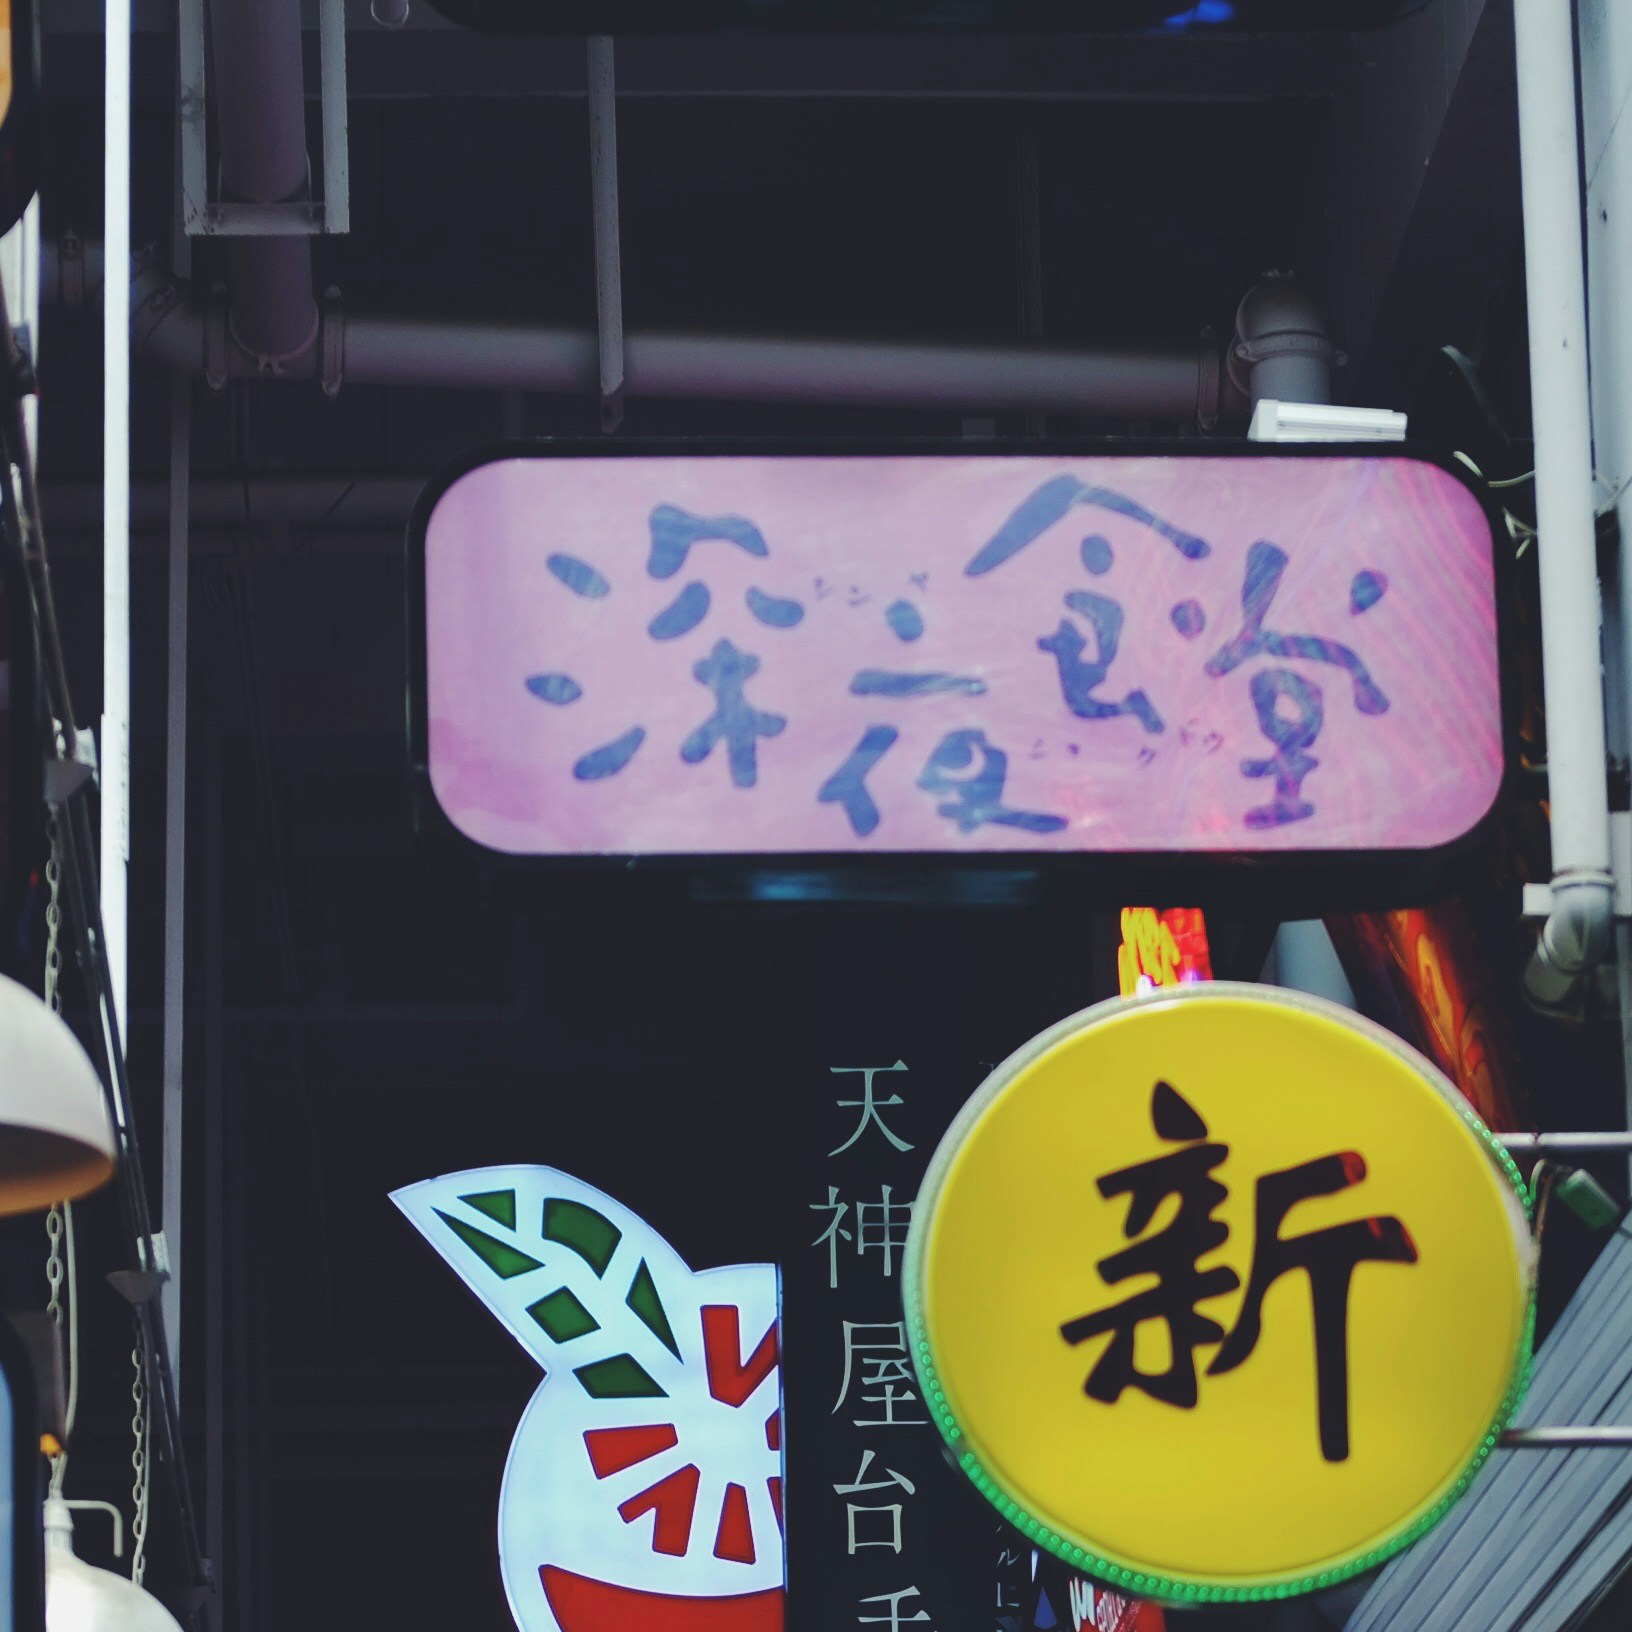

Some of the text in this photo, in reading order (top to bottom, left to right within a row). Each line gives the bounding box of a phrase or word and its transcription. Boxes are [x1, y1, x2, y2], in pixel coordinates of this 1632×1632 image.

[524, 473, 1391, 837] 深夜食堂
[1058, 1078, 1419, 1464] 新
